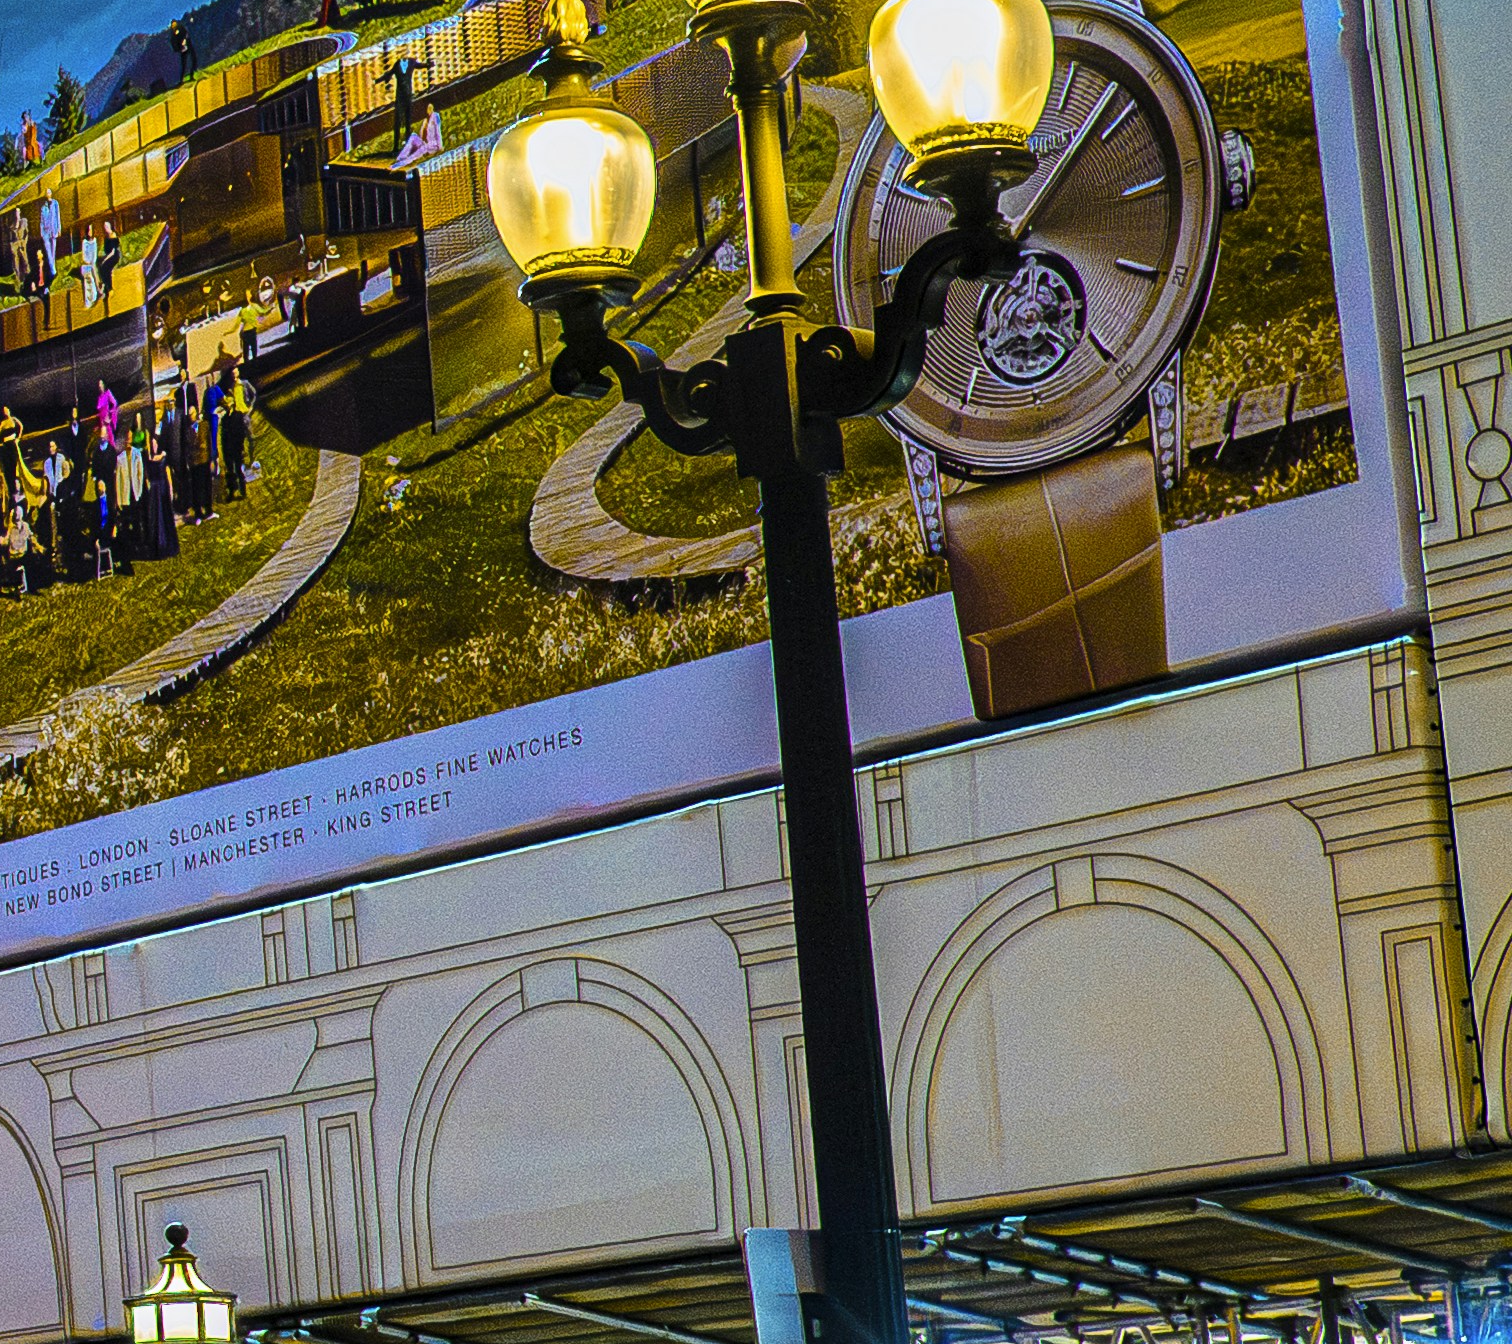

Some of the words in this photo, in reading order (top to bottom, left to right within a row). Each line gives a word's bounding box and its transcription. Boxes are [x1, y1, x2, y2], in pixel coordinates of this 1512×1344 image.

[5, 894, 40, 918] NEW
[47, 881, 94, 906] BOND
[100, 861, 164, 893] STREET
[183, 827, 305, 878] MANCHESTER
[326, 806, 373, 837] KING
[380, 789, 453, 824] STREET
[79, 839, 150, 870] LONDON
[168, 813, 237, 847] SLOANE
[245, 795, 313, 827] STREET
[335, 766, 428, 805] HARRODS
[435, 755, 480, 780] FINE
[488, 726, 584, 767] WATCHES
